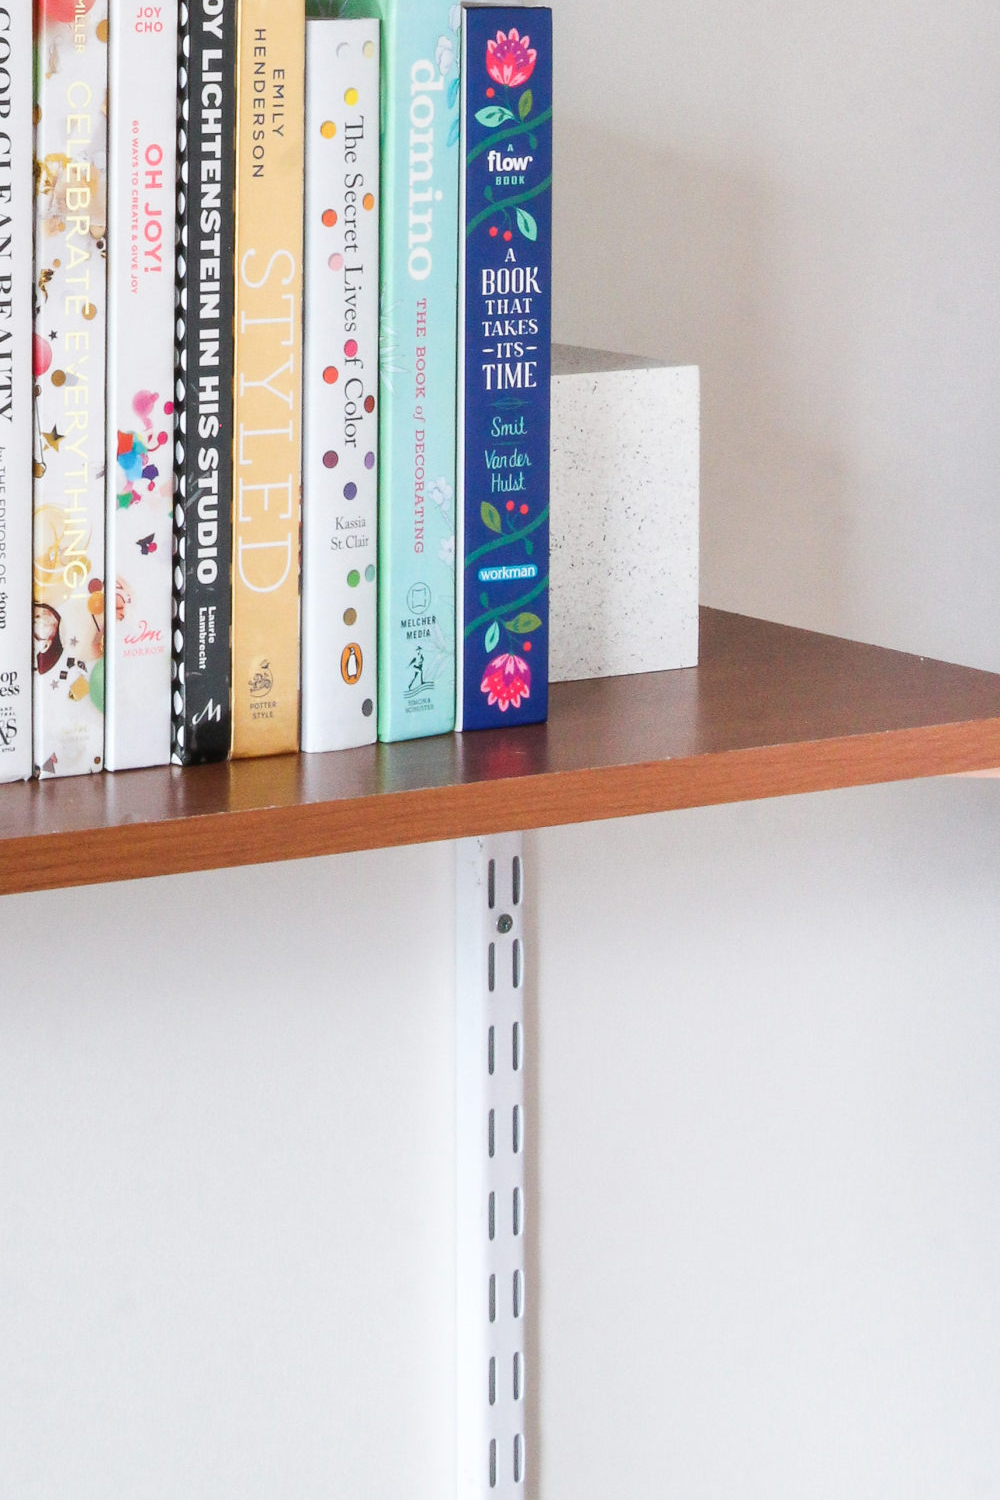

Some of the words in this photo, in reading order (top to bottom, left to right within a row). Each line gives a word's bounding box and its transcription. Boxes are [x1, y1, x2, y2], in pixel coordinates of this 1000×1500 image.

[135, 21, 163, 33] CHO
[136, 7, 162, 19] JOY
[252, 29, 266, 177] HENDERSON
[272, 69, 285, 137] EMILY
[344, 115, 364, 164] The
[144, 144, 163, 189] OH
[407, 59, 444, 281] domino
[488, 151, 533, 172] flow
[132, 172, 139, 185] TO
[199, 49, 223, 318] LICHTENSTEIN
[495, 175, 525, 185] BOOK
[65, 81, 91, 315] CELEBRATE
[344, 173, 364, 252] Secret
[144, 203, 162, 273] JOY!
[505, 248, 516, 262] A
[482, 267, 542, 296] BOOK
[344, 265, 363, 333] Lives
[485, 298, 532, 315] THAT
[416, 299, 426, 337] THE
[482, 318, 538, 337] TAKES
[199, 329, 220, 366] IN
[344, 339, 364, 369] f
[415, 346, 426, 398] BOOK
[482, 361, 537, 390] TIME
[198, 376, 219, 439] HIS
[239, 248, 295, 593] STYLED
[344, 378, 364, 447] Color
[413, 405, 425, 423] of
[491, 416, 528, 437] Smit
[63, 330, 90, 598] EVERYTHING!
[485, 449, 507, 470] Van
[509, 448, 532, 468] der
[414, 429, 426, 554] DECORATING
[492, 472, 526, 492] Hulst
[197, 447, 219, 584] STUDIO
[335, 516, 366, 531] Kassia
[345, 535, 369, 550] Clair
[481, 565, 535, 581] workman
[208, 606, 217, 644] Laurie
[401, 615, 436, 628] MELCHER
[406, 629, 430, 640] MEDIA
[199, 607, 207, 670] Lambrecht
[250, 701, 277, 709] POTTER
[252, 710, 274, 719] STYLE
